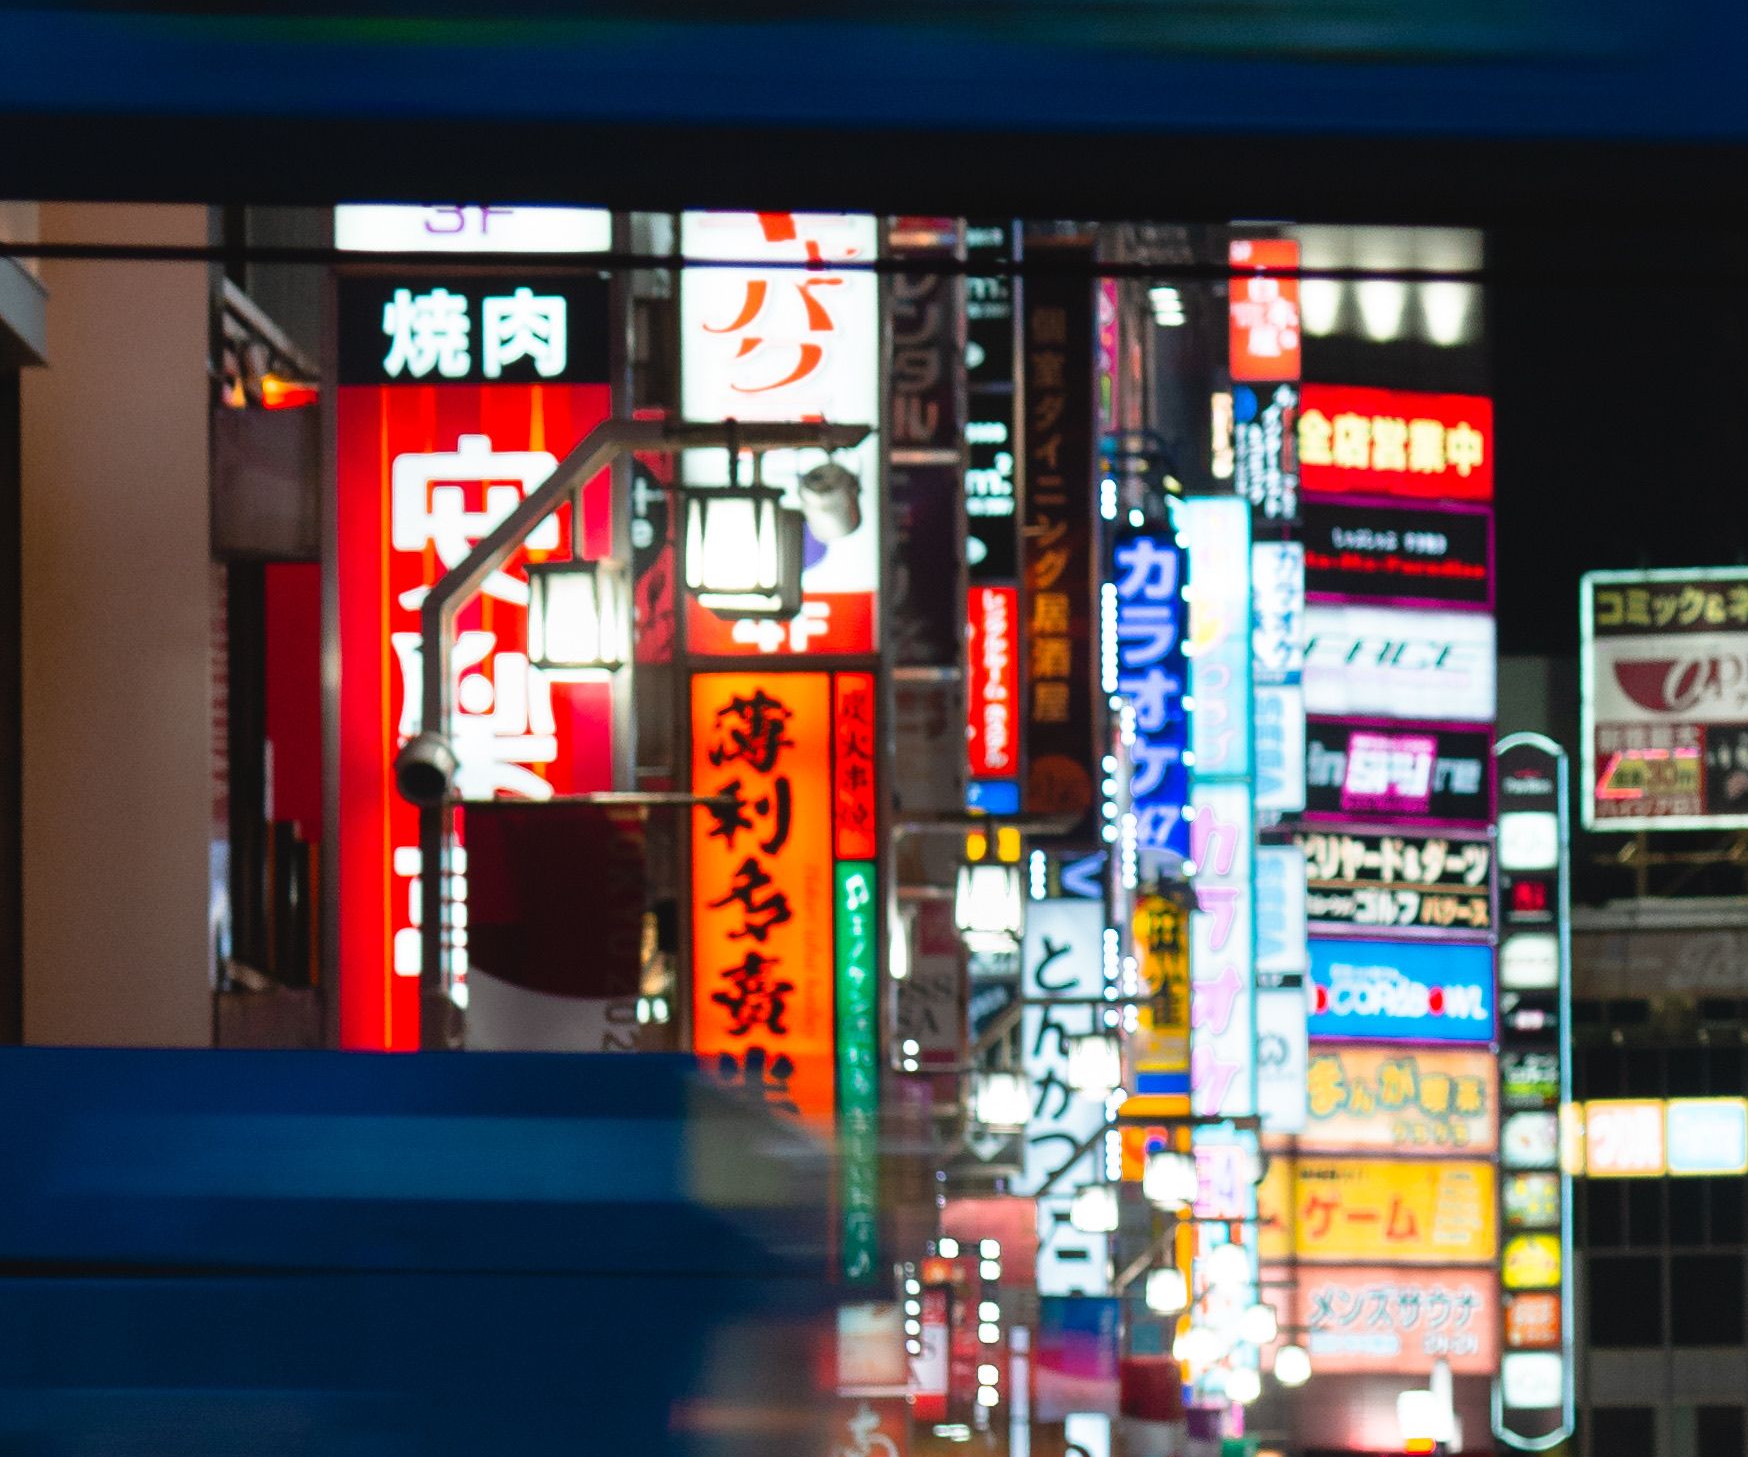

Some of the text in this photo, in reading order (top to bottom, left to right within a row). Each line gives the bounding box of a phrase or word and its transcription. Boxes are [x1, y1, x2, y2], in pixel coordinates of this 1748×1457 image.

[382, 287, 567, 379] 焼肉
[1308, 1286, 1481, 1330] メンズサウナ
